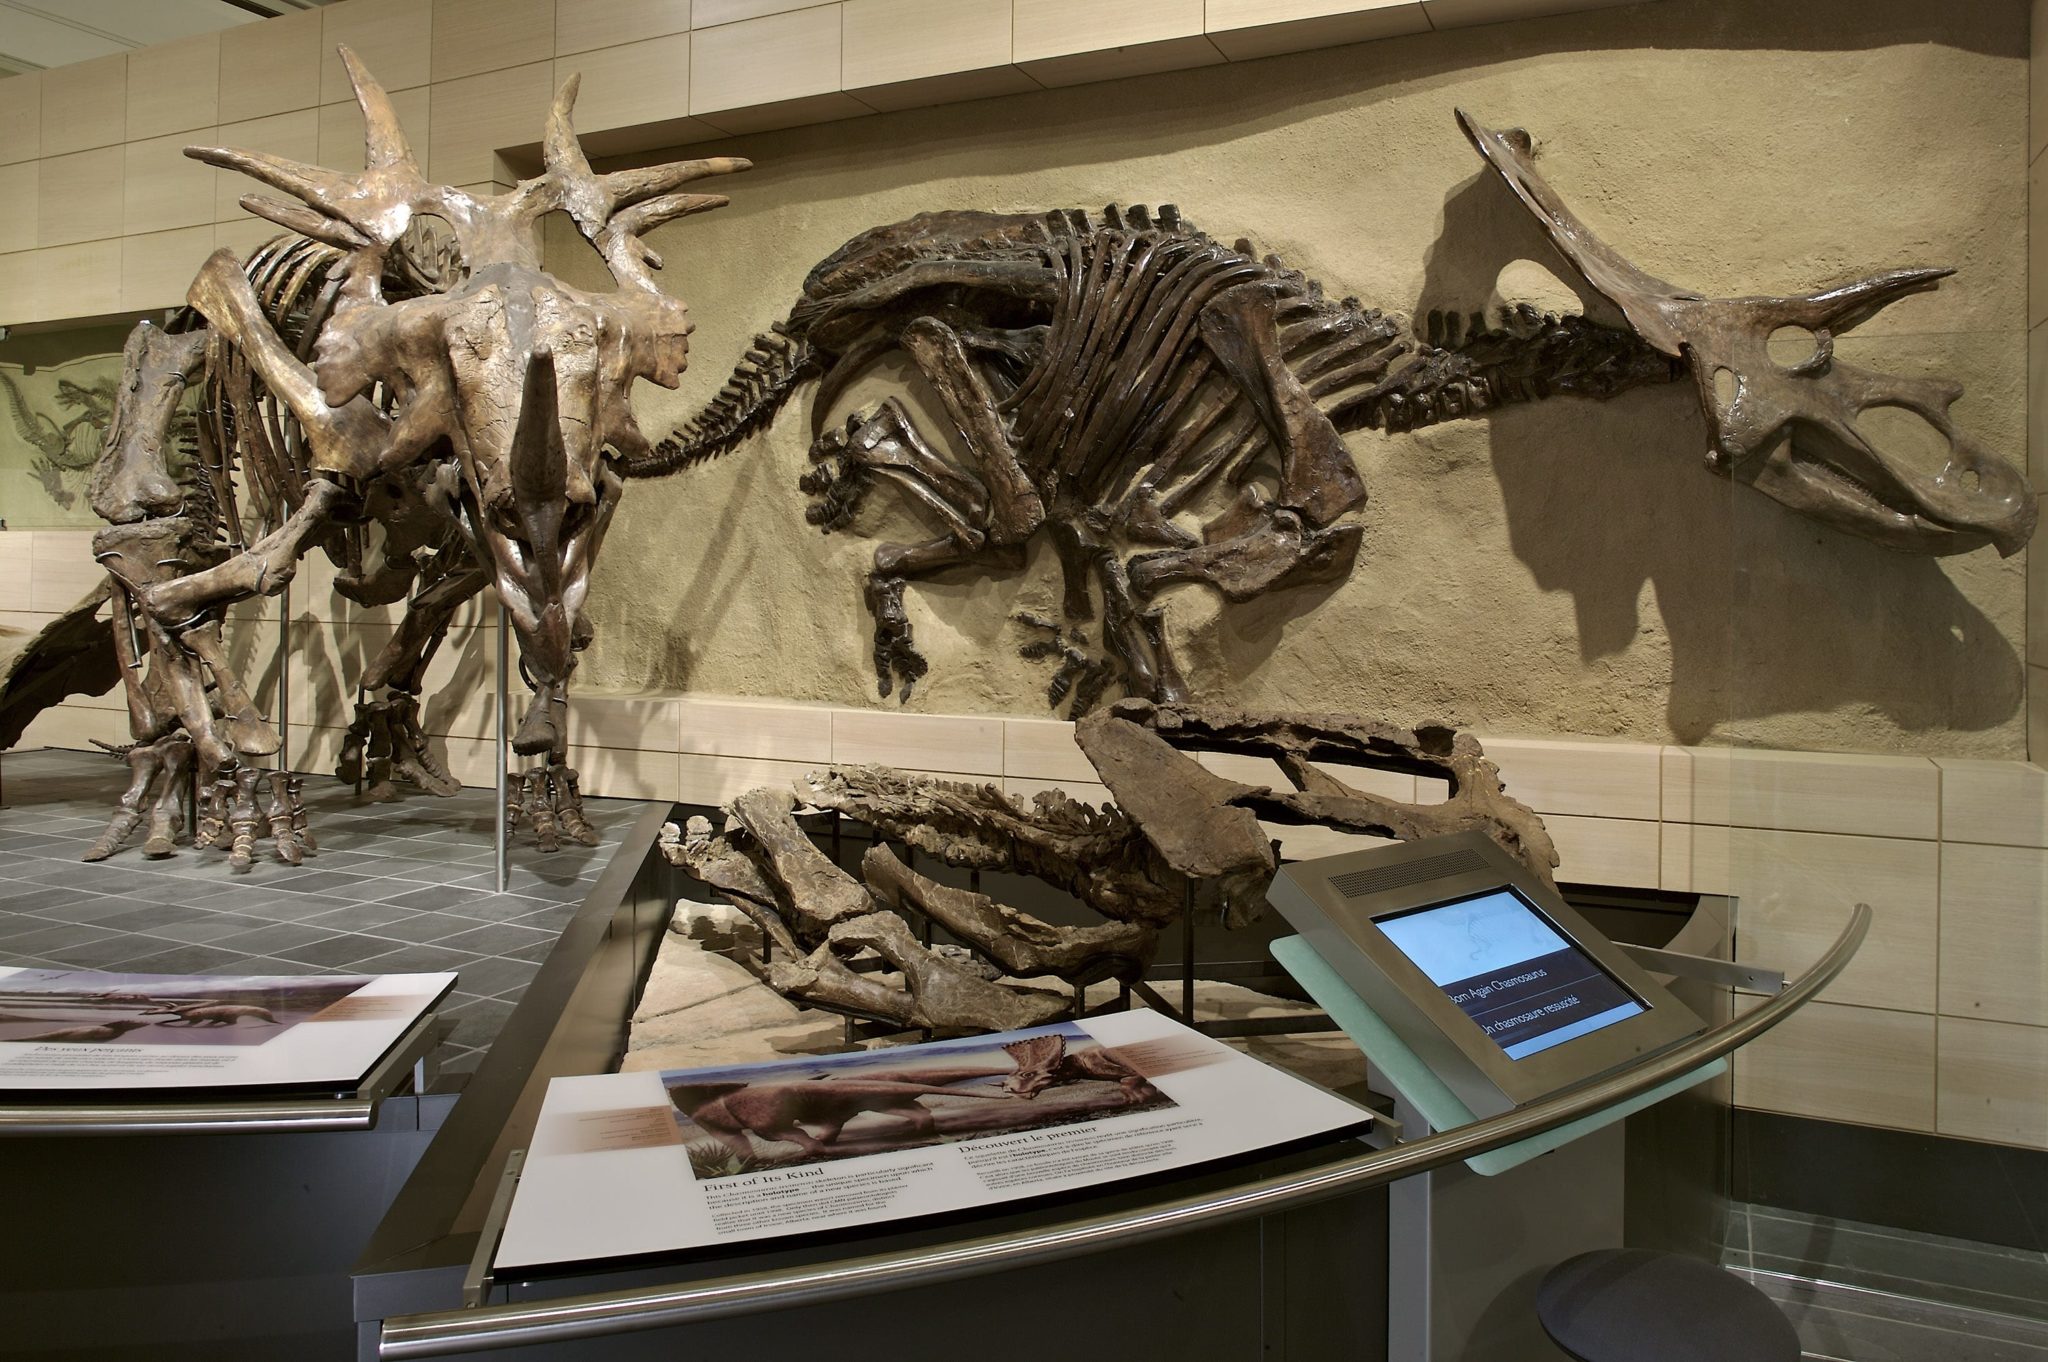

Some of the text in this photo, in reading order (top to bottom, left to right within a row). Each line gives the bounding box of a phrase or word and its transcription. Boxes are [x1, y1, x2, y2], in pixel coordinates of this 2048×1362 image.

[1468, 985, 1494, 999] Again
[1490, 968, 1547, 991] Chasmosaurus
[1494, 1008, 1545, 1031] chasmosaure
[1543, 994, 1580, 1013] ressuscité
[959, 1127, 1096, 1153] Découvert le premier
[704, 1168, 823, 1191] First of Its Kind
[855, 1168, 895, 1177] particularly
[762, 1187, 799, 1196] holotype
